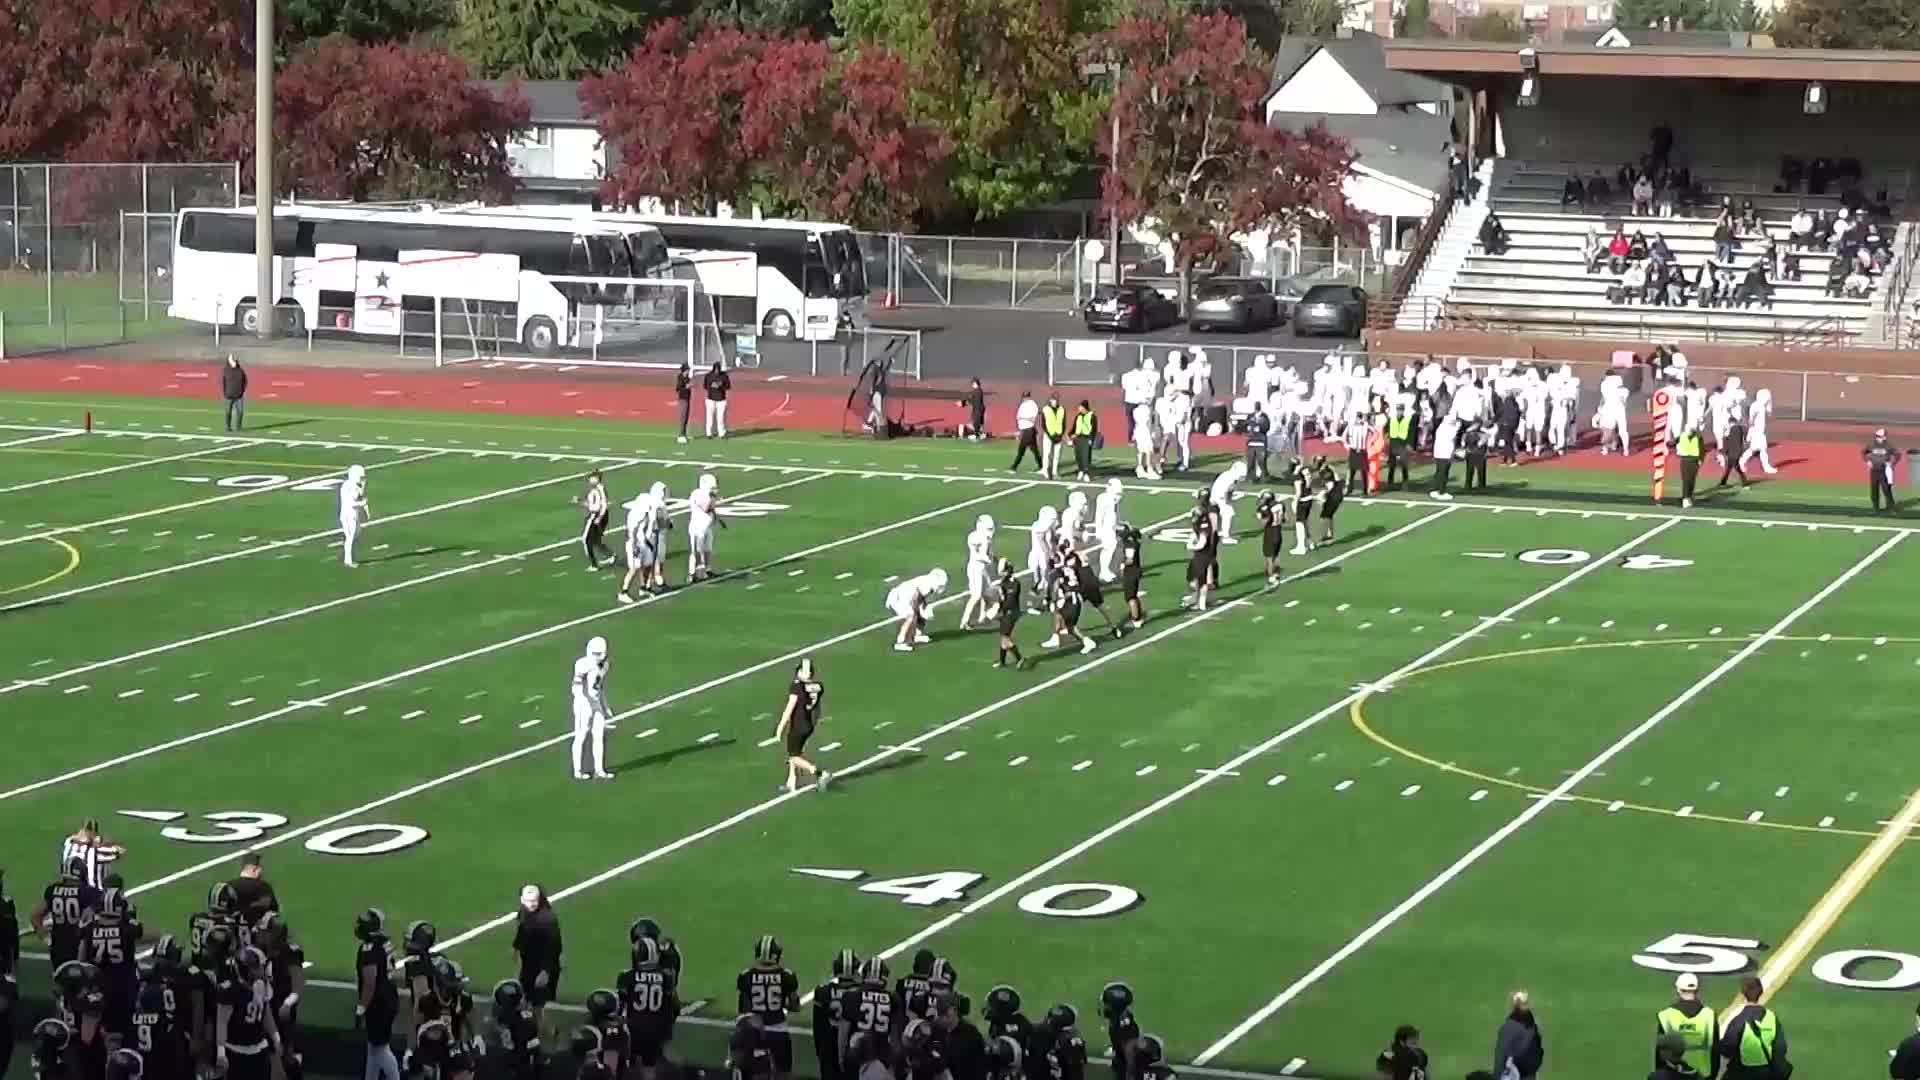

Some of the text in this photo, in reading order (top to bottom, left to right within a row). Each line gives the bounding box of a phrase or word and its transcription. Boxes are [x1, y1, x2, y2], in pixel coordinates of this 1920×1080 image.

[52, 896, 80, 925] 90
[92, 938, 124, 964] 75
[633, 983, 664, 1012] 30
[751, 984, 783, 1012] 26
[857, 1003, 891, 1032] 35
[136, 1025, 153, 1053] 9
